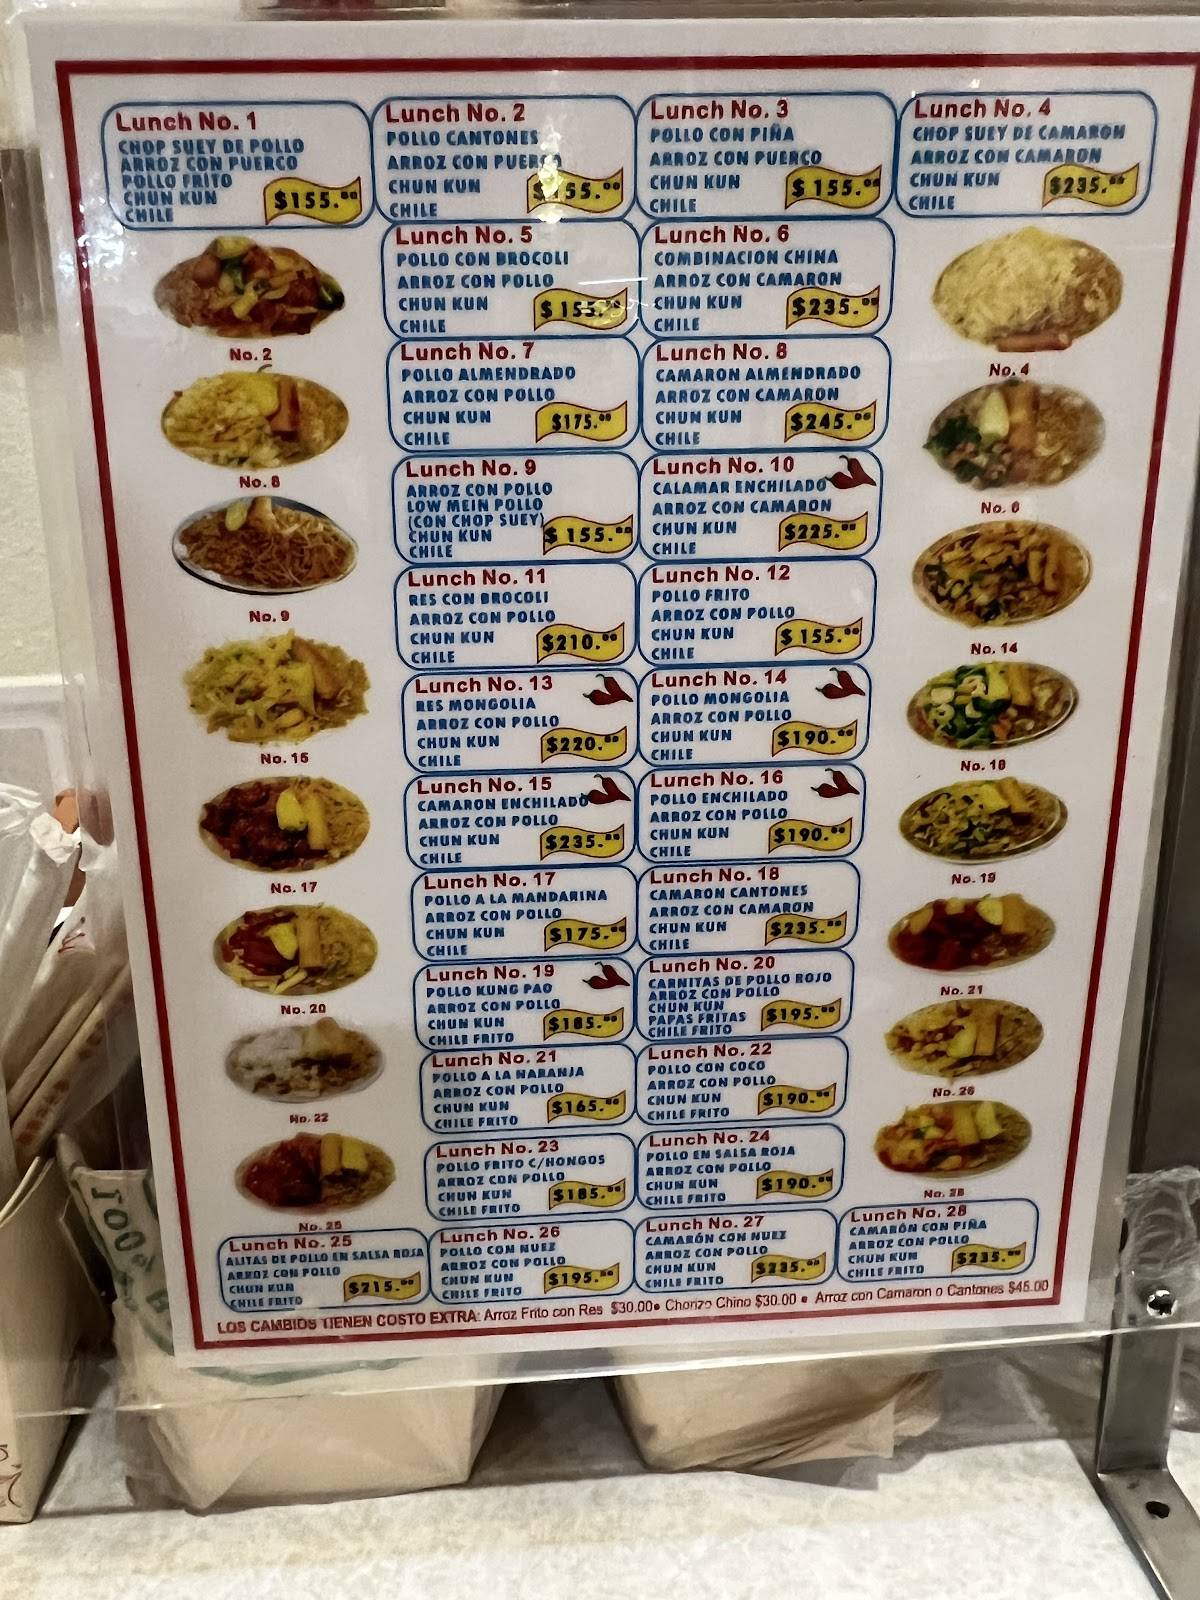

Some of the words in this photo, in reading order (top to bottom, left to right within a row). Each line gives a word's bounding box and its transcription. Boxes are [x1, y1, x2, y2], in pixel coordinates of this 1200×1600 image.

[385, 104, 460, 122] Lunch
[467, 103, 505, 121] No.
[513, 103, 525, 121] 2
[651, 101, 723, 119] Lunch
[731, 101, 769, 118] No.
[776, 100, 788, 118] 3
[914, 100, 986, 118] Lunch
[993, 100, 1031, 117] No.
[1038, 99, 1051, 116] 4
[115, 112, 192, 130] Lunch
[198, 112, 239, 130] No.
[246, 111, 256, 129] 1
[386, 130, 440, 146] POLLO
[446, 129, 538, 145] CANTONES
[650, 127, 703, 142] POLLO
[709, 126, 744, 141] CON
[395, 227, 468, 245] Lunch
[475, 226, 513, 244] No.
[520, 226, 532, 243] 5
[654, 225, 726, 243] Lunch
[733, 225, 769, 242] No.
[777, 224, 789, 241] 6
[396, 252, 449, 267] POLLO
[454, 251, 490, 267] CON
[654, 250, 778, 266] COMBINACION
[784, 249, 838, 264] CHINA
[400, 343, 471, 361] Lunch
[478, 343, 515, 359] No.
[522, 342, 534, 358] 7
[656, 343, 726, 361] Lunch
[732, 343, 768, 359] No.
[776, 342, 787, 358] 8
[401, 367, 453, 382] POLLO
[458, 366, 576, 381] ALMENDRADO
[655, 367, 740, 382] CAMARON
[745, 365, 861, 380] ALMENDRADO
[655, 389, 710, 404] ARROZ
[716, 388, 749, 403] CON
[755, 387, 839, 402] CAMARON
[404, 431, 450, 445] CHILE
[405, 461, 474, 478] Lunch
[482, 461, 517, 476] No.
[524, 460, 536, 475] 9
[653, 458, 721, 475] Lunch
[728, 457, 763, 473] No.
[770, 456, 794, 472] 10
[406, 483, 461, 498] ARROZ
[465, 483, 498, 497] CON
[503, 482, 552, 496] POLLO
[653, 480, 730, 495] CALAMAR
[735, 476, 826, 493] ENCHILADO
[407, 499, 441, 513] LOW
[446, 498, 488, 512] MEIN
[494, 497, 543, 511] POLLO
[408, 529, 453, 544] CHUN
[458, 528, 492, 542] KUN
[409, 544, 453, 559] CHILE
[408, 570, 475, 587] Lunch
[482, 569, 518, 585] No.
[524, 568, 545, 583] 11
[652, 566, 718, 583] Lunch
[725, 566, 759, 581] No.
[767, 564, 790, 580] 12
[441, 592, 475, 605] CON
[652, 588, 700, 602] POLLO
[705, 588, 750, 600] FRITO
[409, 612, 464, 626] ARROZ
[468, 611, 501, 624] CON
[506, 609, 555, 623] POLLO
[651, 628, 695, 641] CHUN
[700, 626, 734, 640] KUN
[415, 677, 481, 694] Lunch
[487, 676, 522, 691] No.
[529, 675, 553, 690] 13
[651, 671, 717, 687] Lunch
[723, 670, 757, 685] No.
[764, 669, 787, 683] 14
[448, 697, 536, 711] MONGOLIA
[651, 693, 699, 706] POLLO
[703, 690, 789, 705] MONGOLIA
[650, 772, 714, 788] Lunch
[720, 771, 753, 785] No.
[760, 769, 783, 783] 16
[650, 792, 696, 806] POLLO
[702, 790, 788, 804] ENCHILADO
[649, 828, 692, 840] CHUN
[697, 826, 729, 839] KUN
[424, 874, 487, 890] Lunch
[493, 873, 527, 887] No.
[533, 871, 556, 885] 17
[424, 894, 470, 907] POLLO
[475, 893, 485, 905] A
[489, 893, 507, 904] LA
[649, 887, 725, 901] CAMARON
[730, 884, 807, 898] CANTONES
[426, 967, 488, 982] Lunch
[493, 966, 526, 979] No.
[532, 964, 554, 977] 19
[431, 1053, 492, 1068] Lunch
[498, 1052, 530, 1065] No.
[536, 1049, 556, 1063] 21
[436, 1143, 495, 1158] Lunch
[501, 1142, 532, 1154] No.
[537, 1139, 559, 1152] 23
[436, 1161, 480, 1173] POLLO
[484, 1159, 524, 1170] FRITO
[850, 1208, 906, 1222] Lunch
[912, 1206, 940, 1218] No.
[946, 1204, 967, 1216] 28
[646, 1218, 702, 1232] Lunch
[708, 1217, 738, 1229] No.
[743, 1215, 764, 1227] 27
